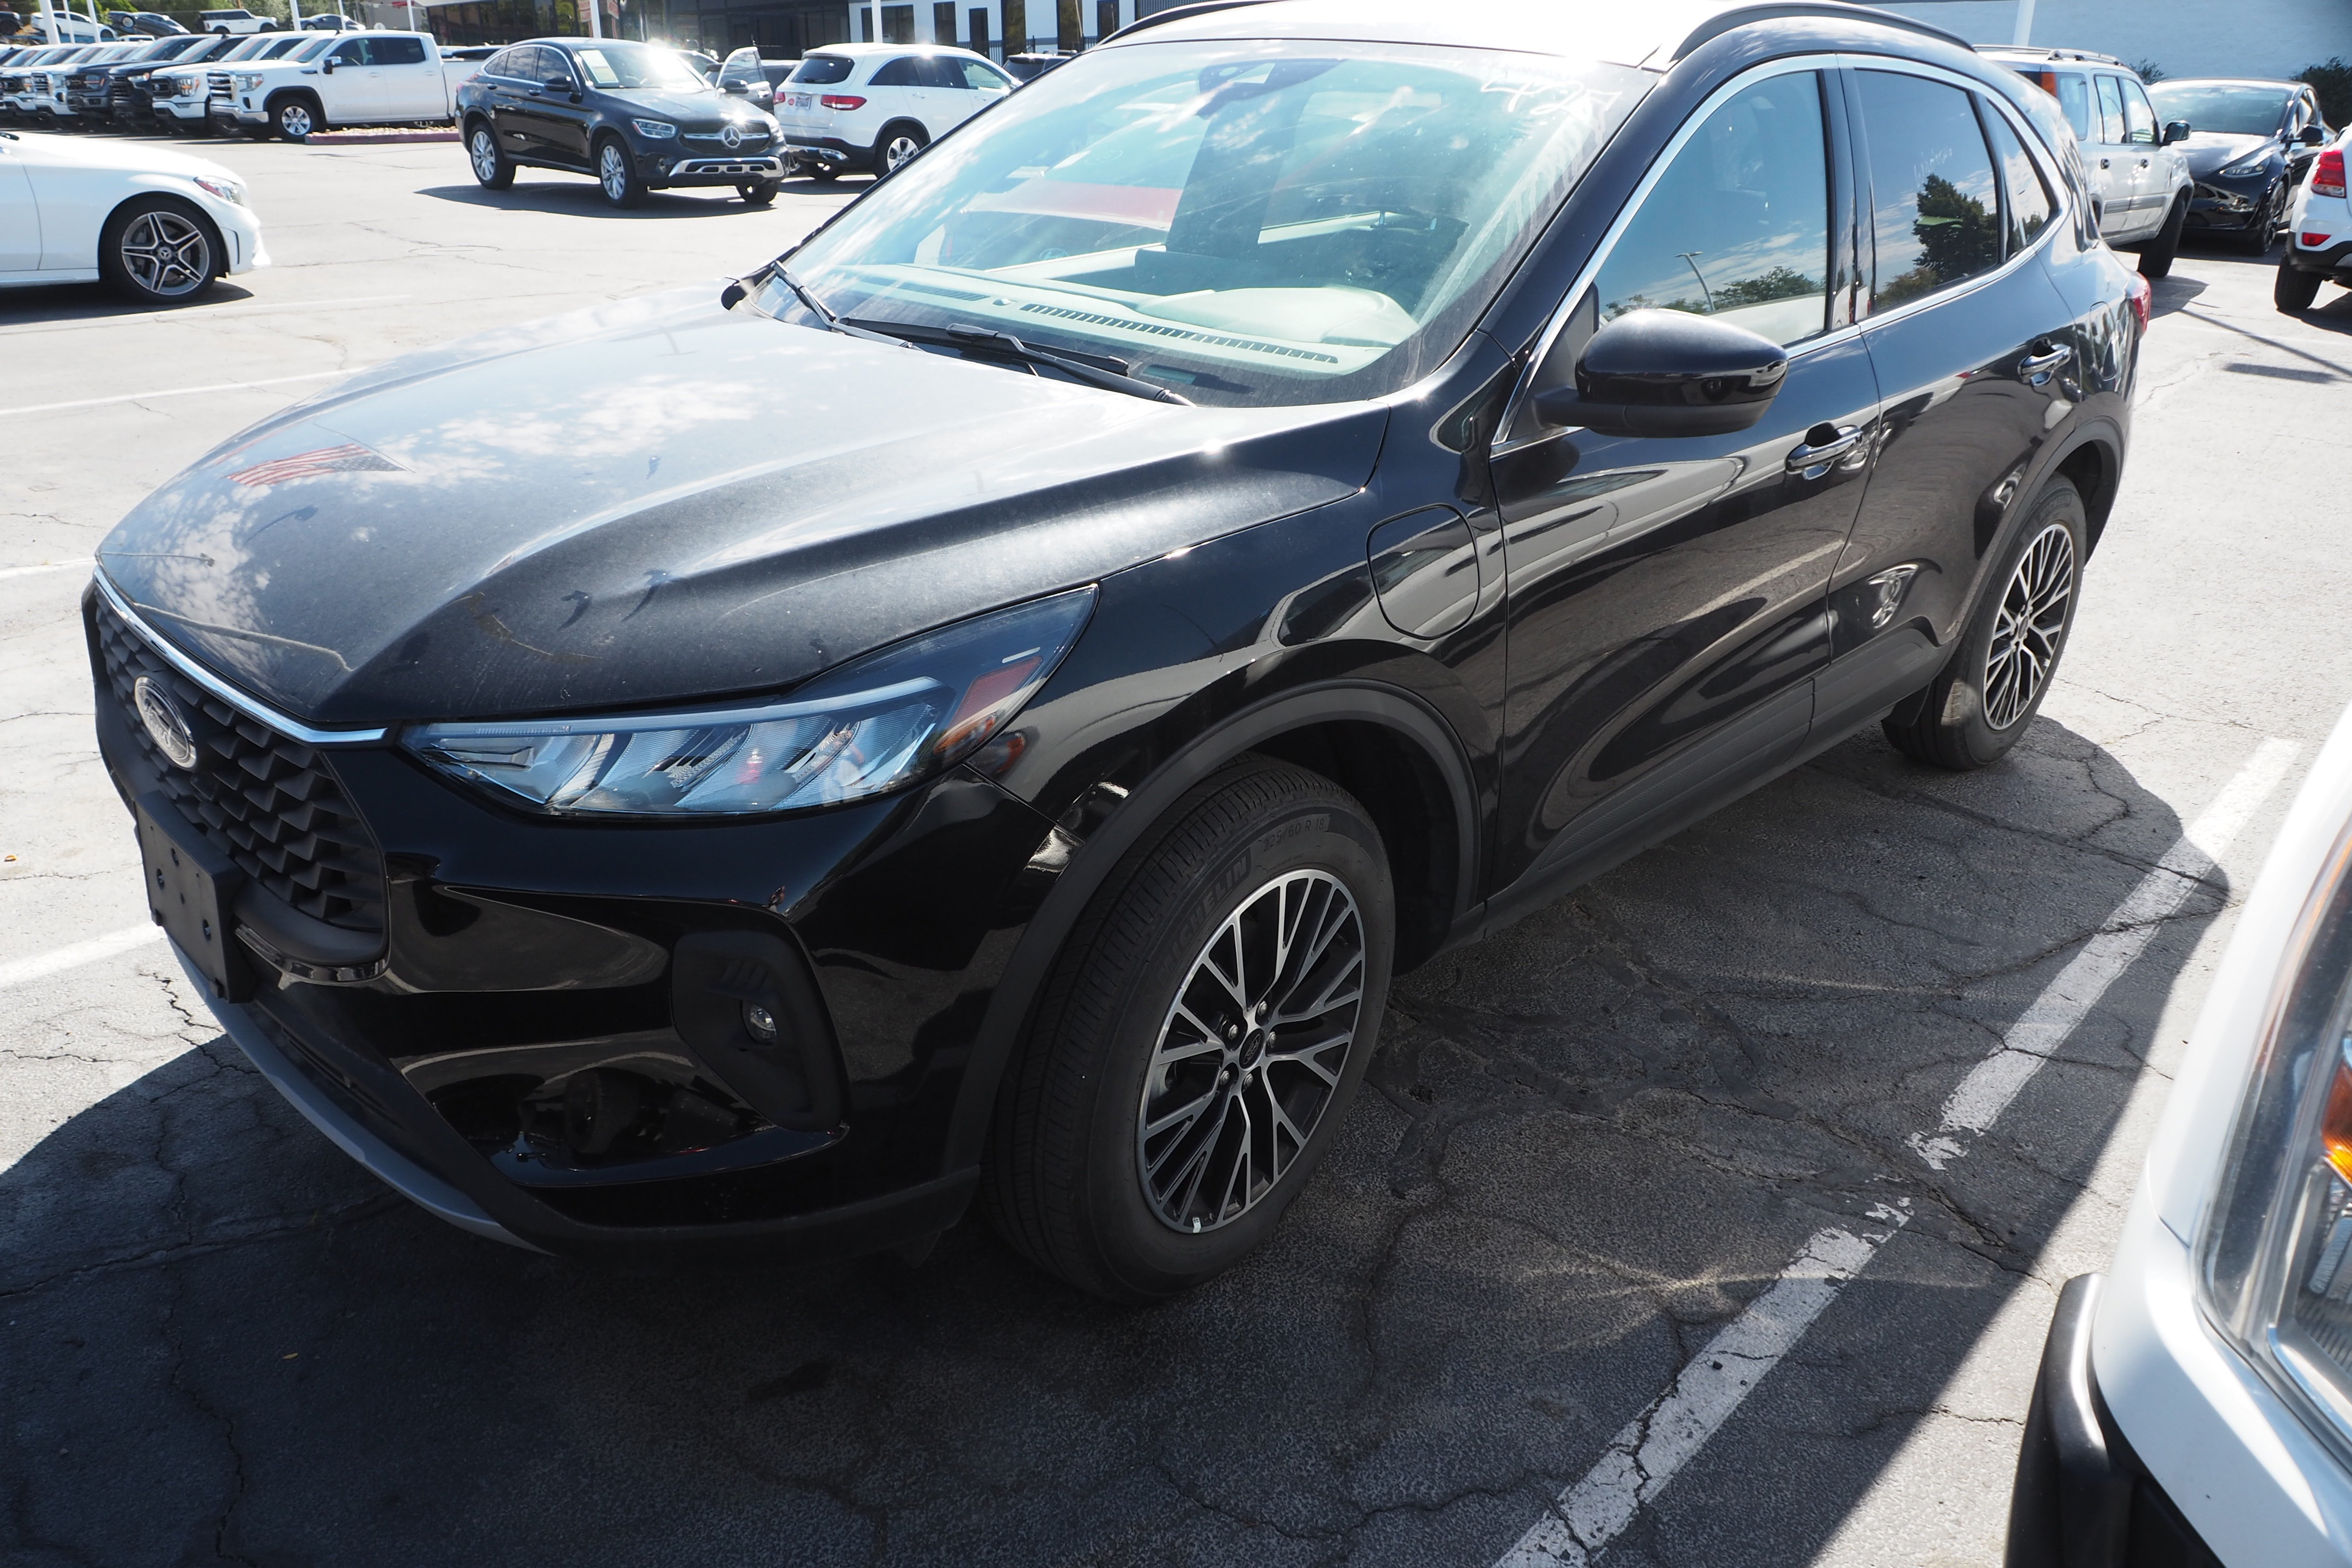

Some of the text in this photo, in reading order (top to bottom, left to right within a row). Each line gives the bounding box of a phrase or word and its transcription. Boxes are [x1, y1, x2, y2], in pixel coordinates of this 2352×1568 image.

[1263, 818, 1325, 852] 225/60 R 18
[1155, 855, 1247, 988] MICHELIN
